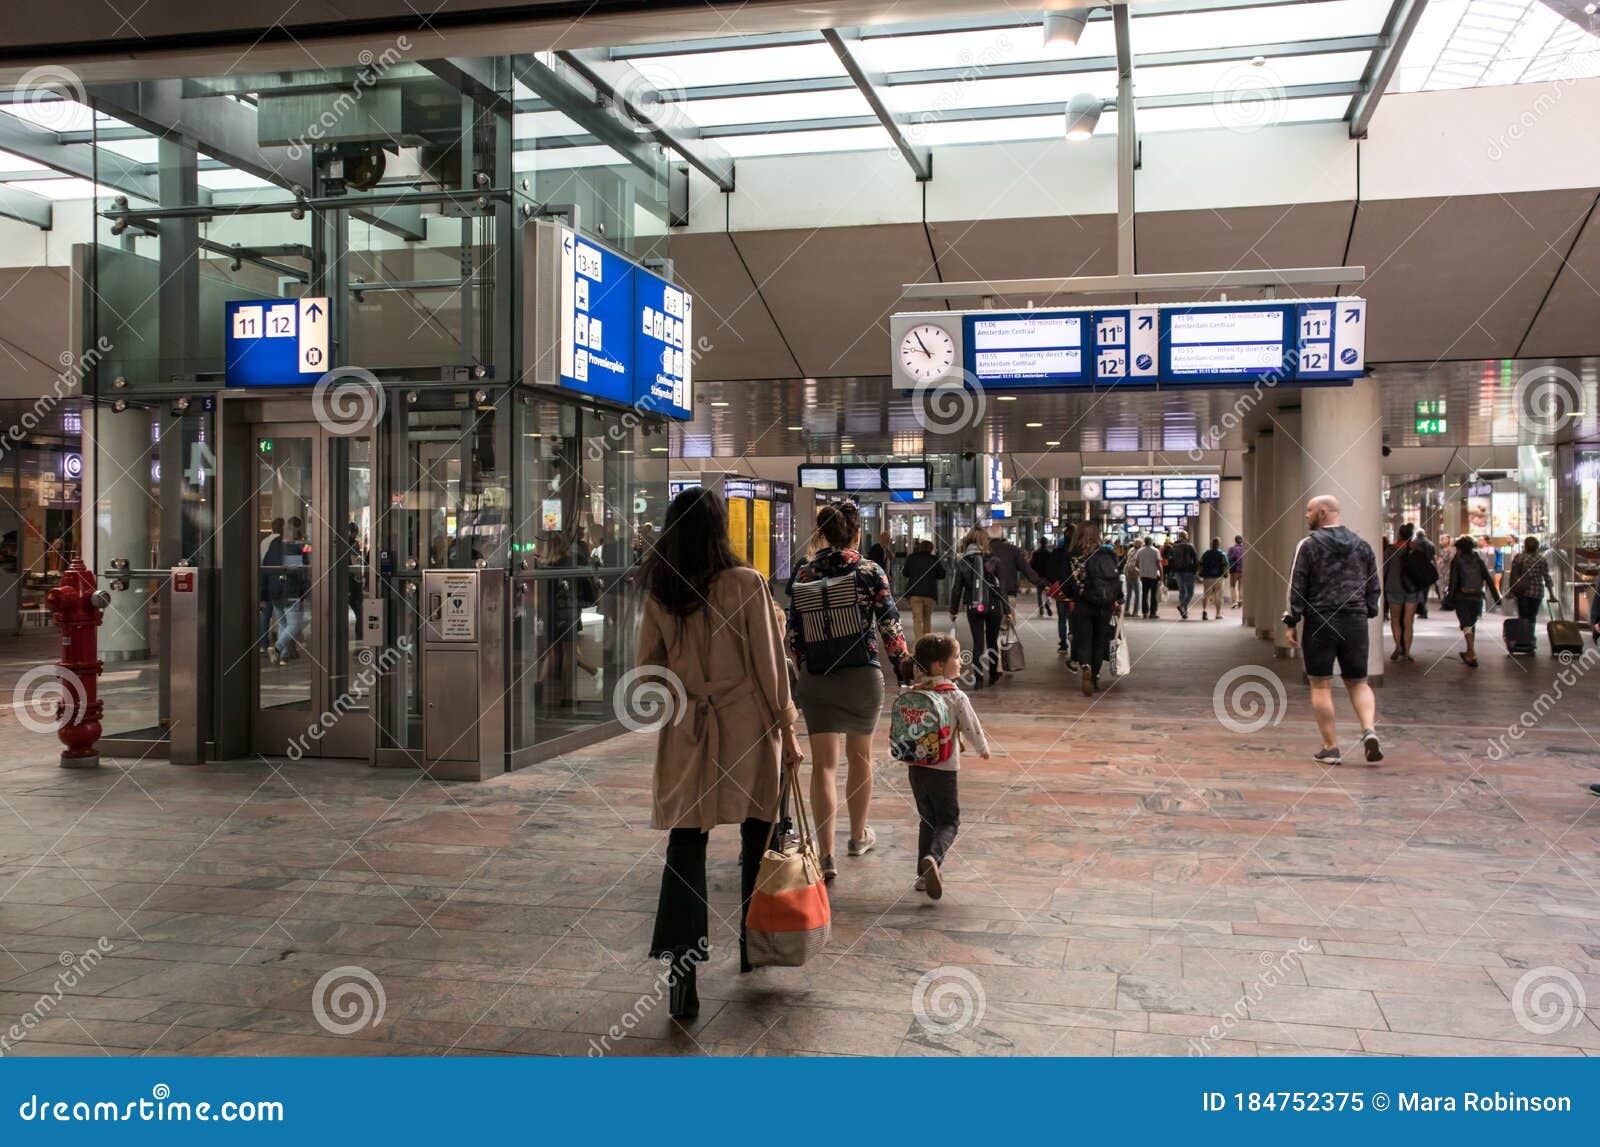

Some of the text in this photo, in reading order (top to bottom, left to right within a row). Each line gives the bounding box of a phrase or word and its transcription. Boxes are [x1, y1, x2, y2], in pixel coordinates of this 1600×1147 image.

[577, 253, 600, 278] 13-16
[239, 317, 290, 335] 11 12
[1019, 352, 1044, 360] Intercity
[1217, 347, 1243, 355] Intercity
[205, 399, 212, 409] 5
